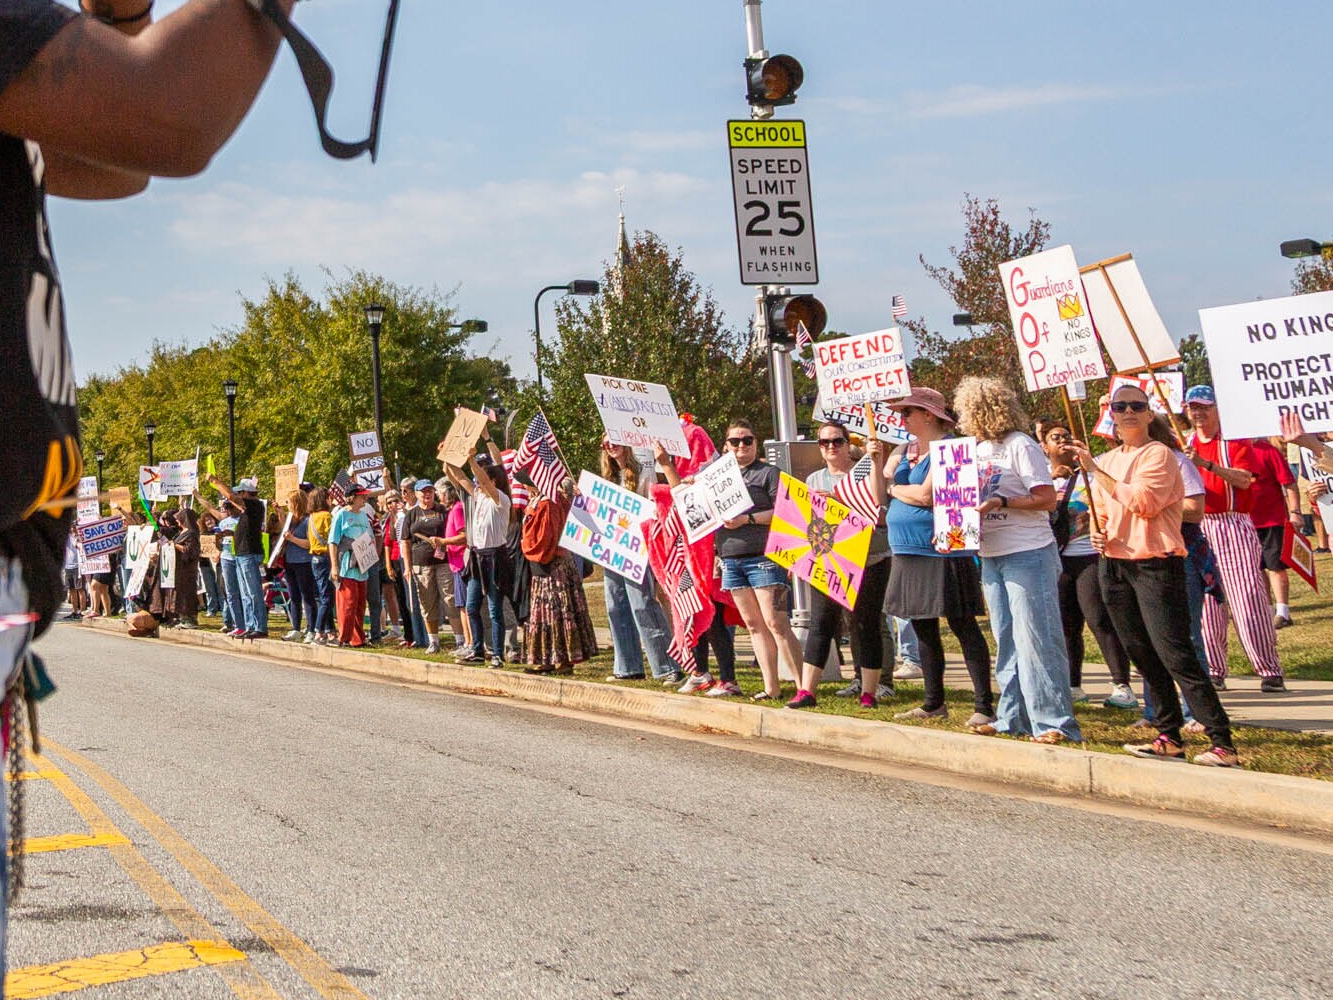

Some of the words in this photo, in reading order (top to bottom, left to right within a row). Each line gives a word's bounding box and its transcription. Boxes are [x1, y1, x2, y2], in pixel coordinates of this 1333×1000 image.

[733, 126, 802, 142] SCHOOL
[737, 158, 802, 175] SPEED
[745, 179, 796, 195] LIMIT
[743, 200, 805, 237] 25
[759, 246, 796, 256] WHEN
[747, 262, 812, 272] FLASHING
[1010, 267, 1074, 307] Guardians
[1019, 311, 1050, 349] Of
[1067, 318, 1081, 330] NO
[1246, 322, 1277, 344] NO
[1064, 327, 1091, 343] KINGS
[818, 335, 894, 367] DEFEND
[824, 364, 845, 379] OUR
[1028, 350, 1098, 391] Pedophiles
[1241, 353, 1332, 381] PROTECT
[601, 377, 625, 391] PICK
[626, 381, 649, 394] ONE
[832, 368, 903, 395] PROTECT
[1263, 375, 1333, 401] HUMAN
[870, 391, 882, 400] OF
[631, 416, 648, 428] OR
[356, 438, 374, 449] NO
[352, 456, 385, 471] KINGS
[939, 445, 946, 467] I
[951, 443, 973, 466] WILL
[946, 465, 961, 486] NOT
[709, 477, 733, 497] TURD
[591, 480, 642, 516] HITLER
[714, 490, 744, 515] REICH
[83, 525, 107, 541] SAVE
[565, 521, 602, 547] WITH
[591, 543, 643, 580] CAMPS
[774, 545, 796, 566] HAS
